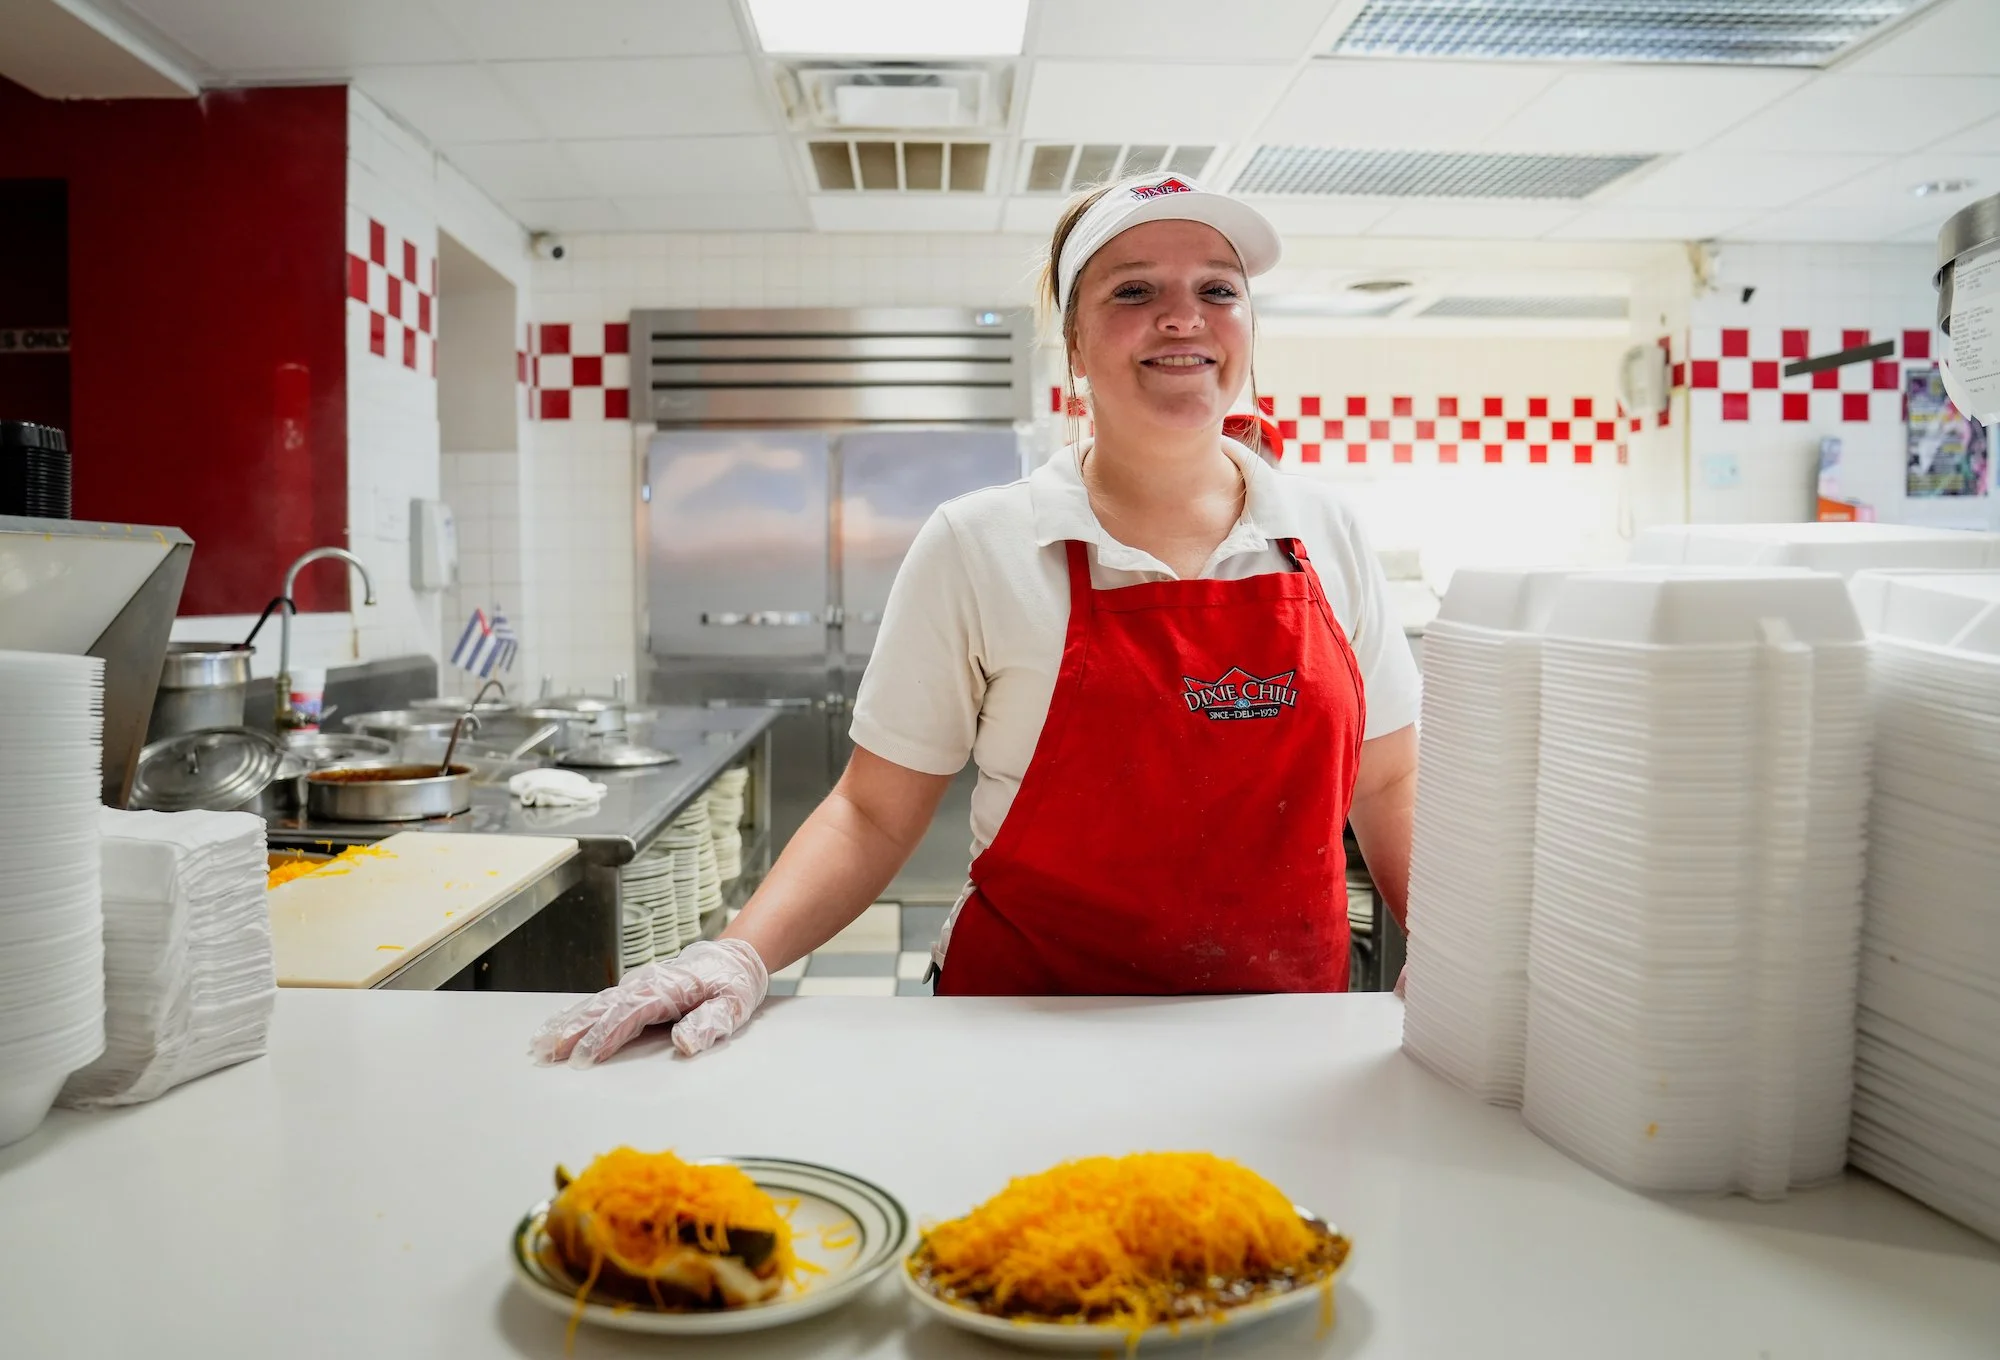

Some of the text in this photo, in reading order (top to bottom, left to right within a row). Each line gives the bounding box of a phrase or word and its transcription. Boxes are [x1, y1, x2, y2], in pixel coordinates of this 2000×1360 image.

[1131, 186, 1174, 201] DIXIE
[1184, 681, 1297, 711] DIXIE CHILI
